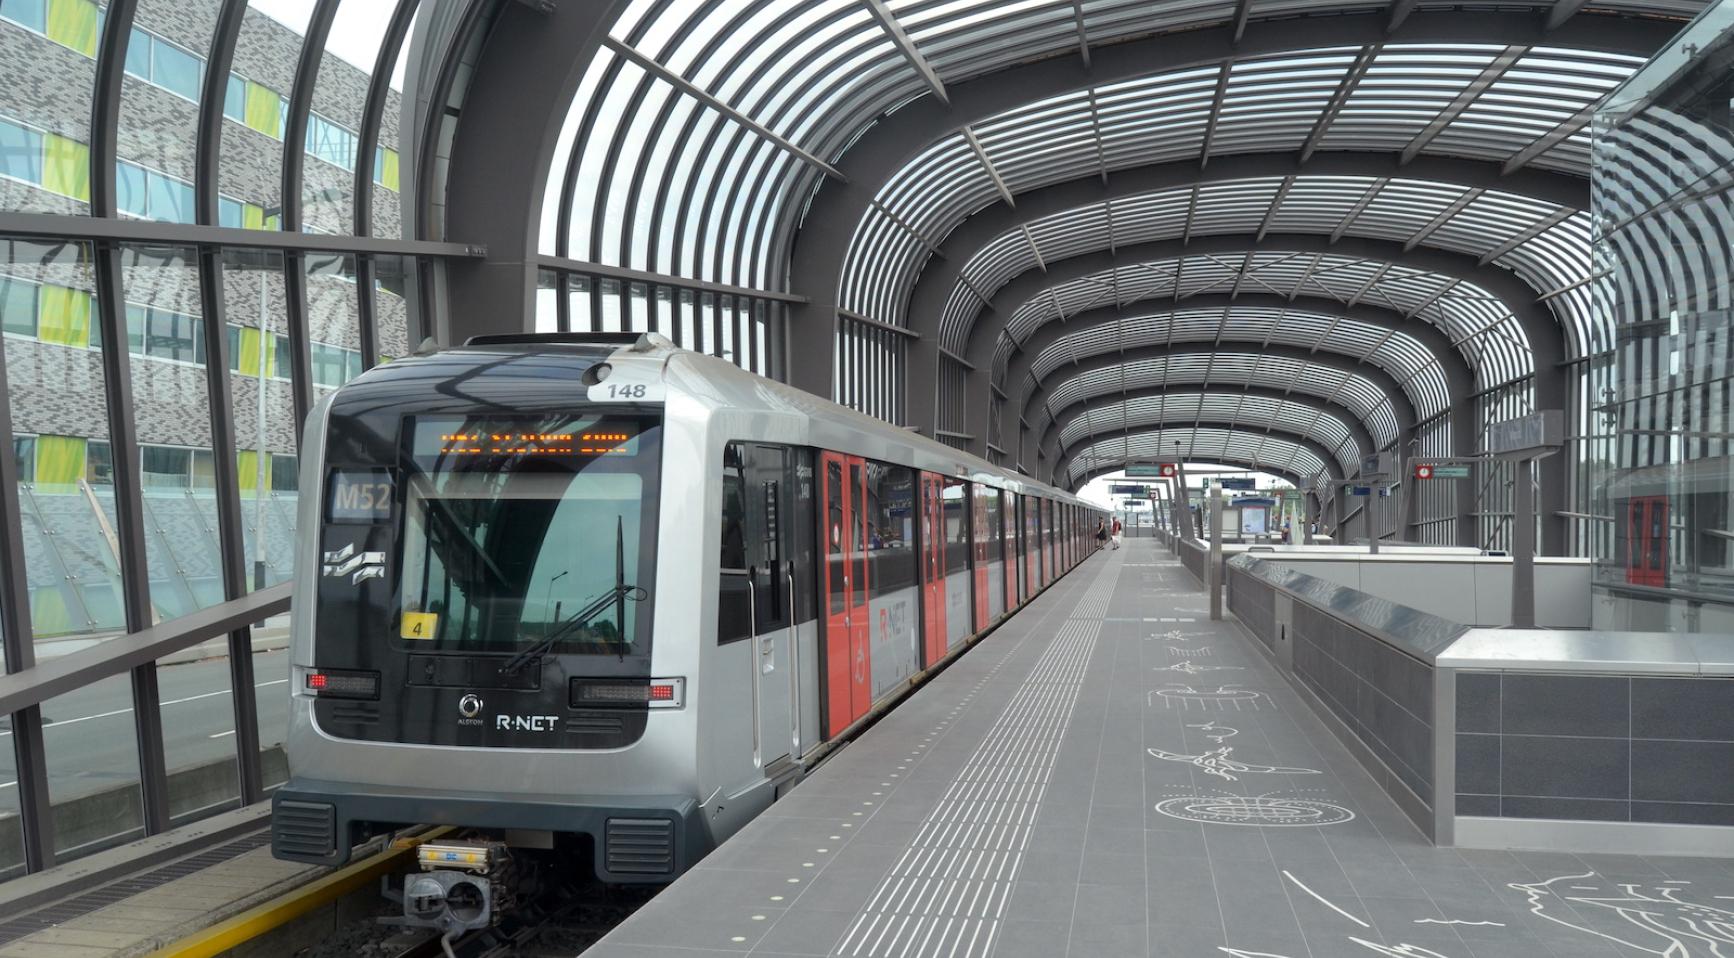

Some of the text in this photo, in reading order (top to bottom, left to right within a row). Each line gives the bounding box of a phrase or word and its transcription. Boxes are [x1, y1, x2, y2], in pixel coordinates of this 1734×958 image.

[607, 383, 646, 399] 148
[335, 482, 391, 511] M52
[412, 622, 422, 636] 4
